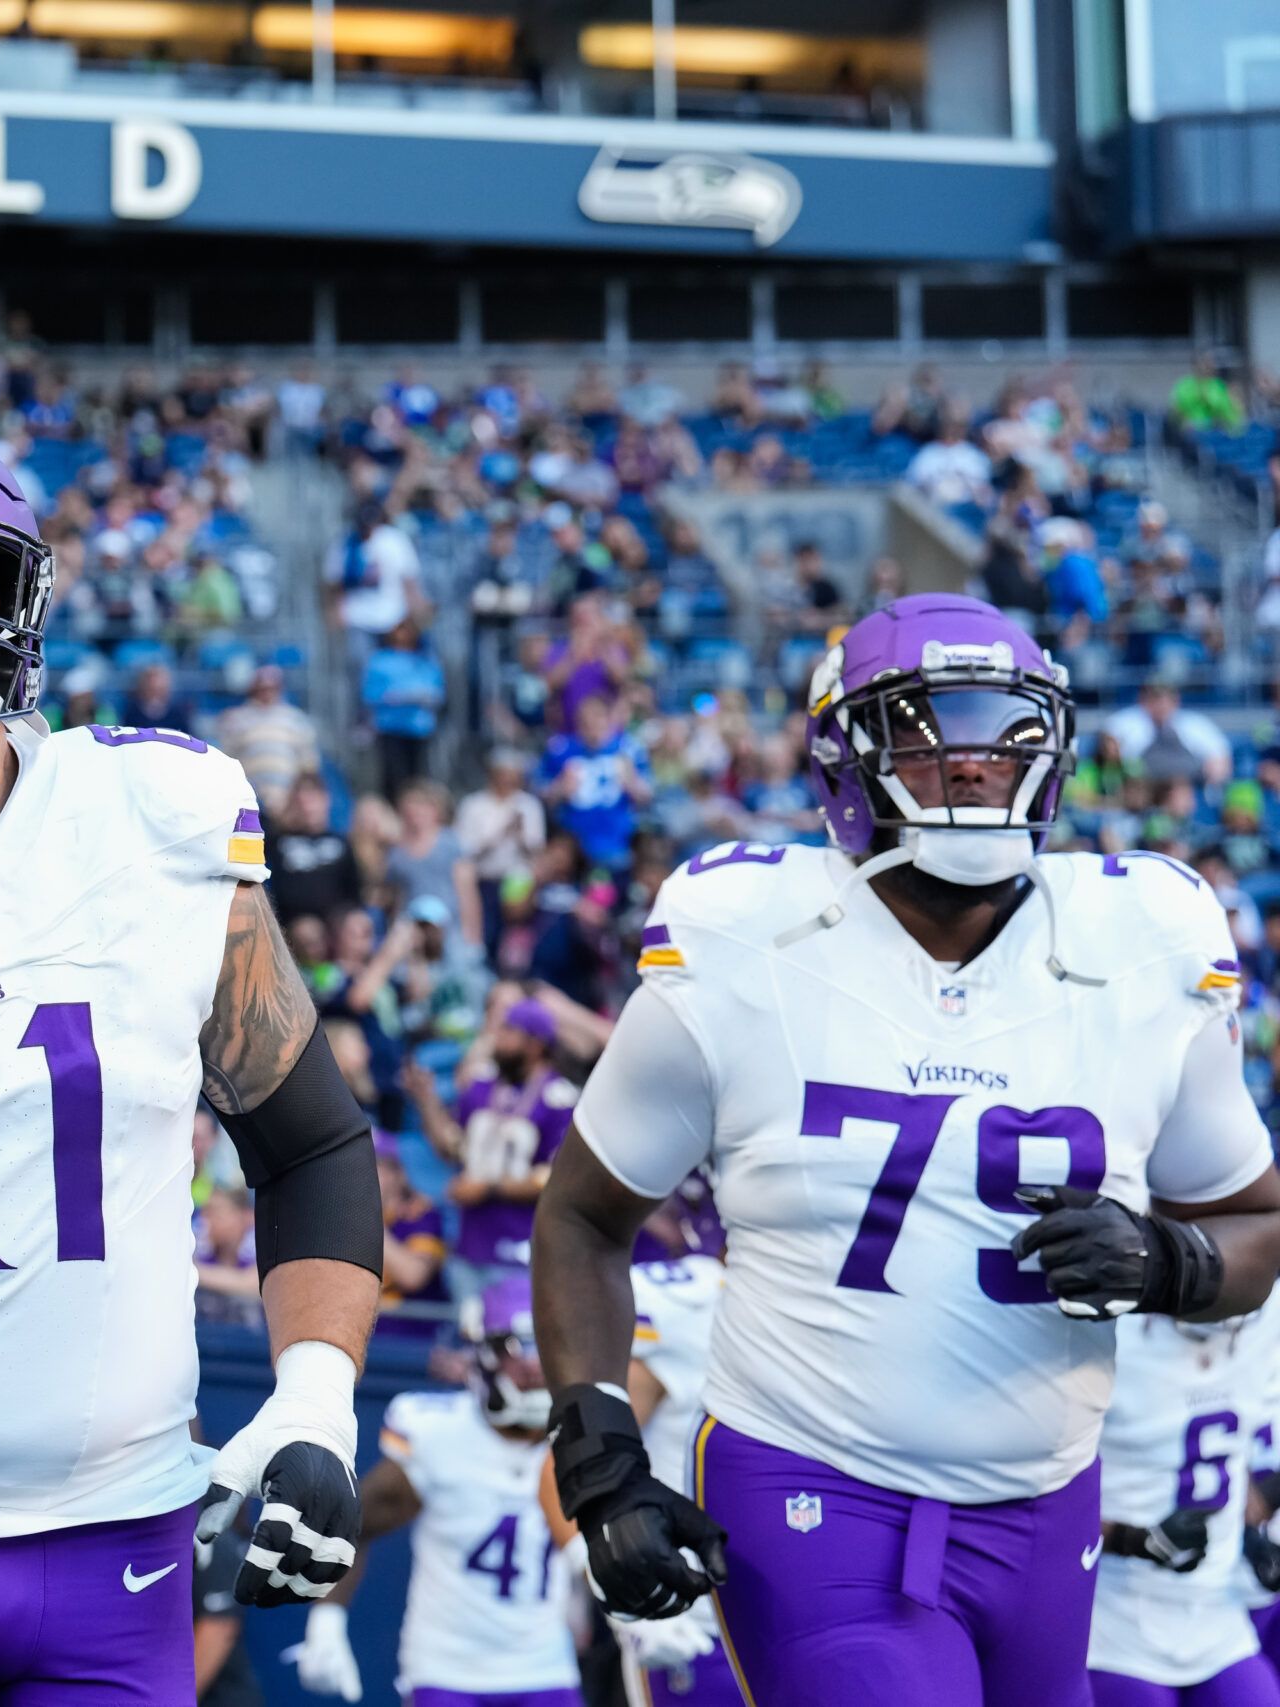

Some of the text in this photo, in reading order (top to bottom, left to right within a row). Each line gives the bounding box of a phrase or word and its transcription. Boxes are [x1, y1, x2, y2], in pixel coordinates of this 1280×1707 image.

[800, 1080, 1107, 1304] 79
[1175, 1410, 1239, 1511] 6
[466, 1513, 552, 1601] 4
